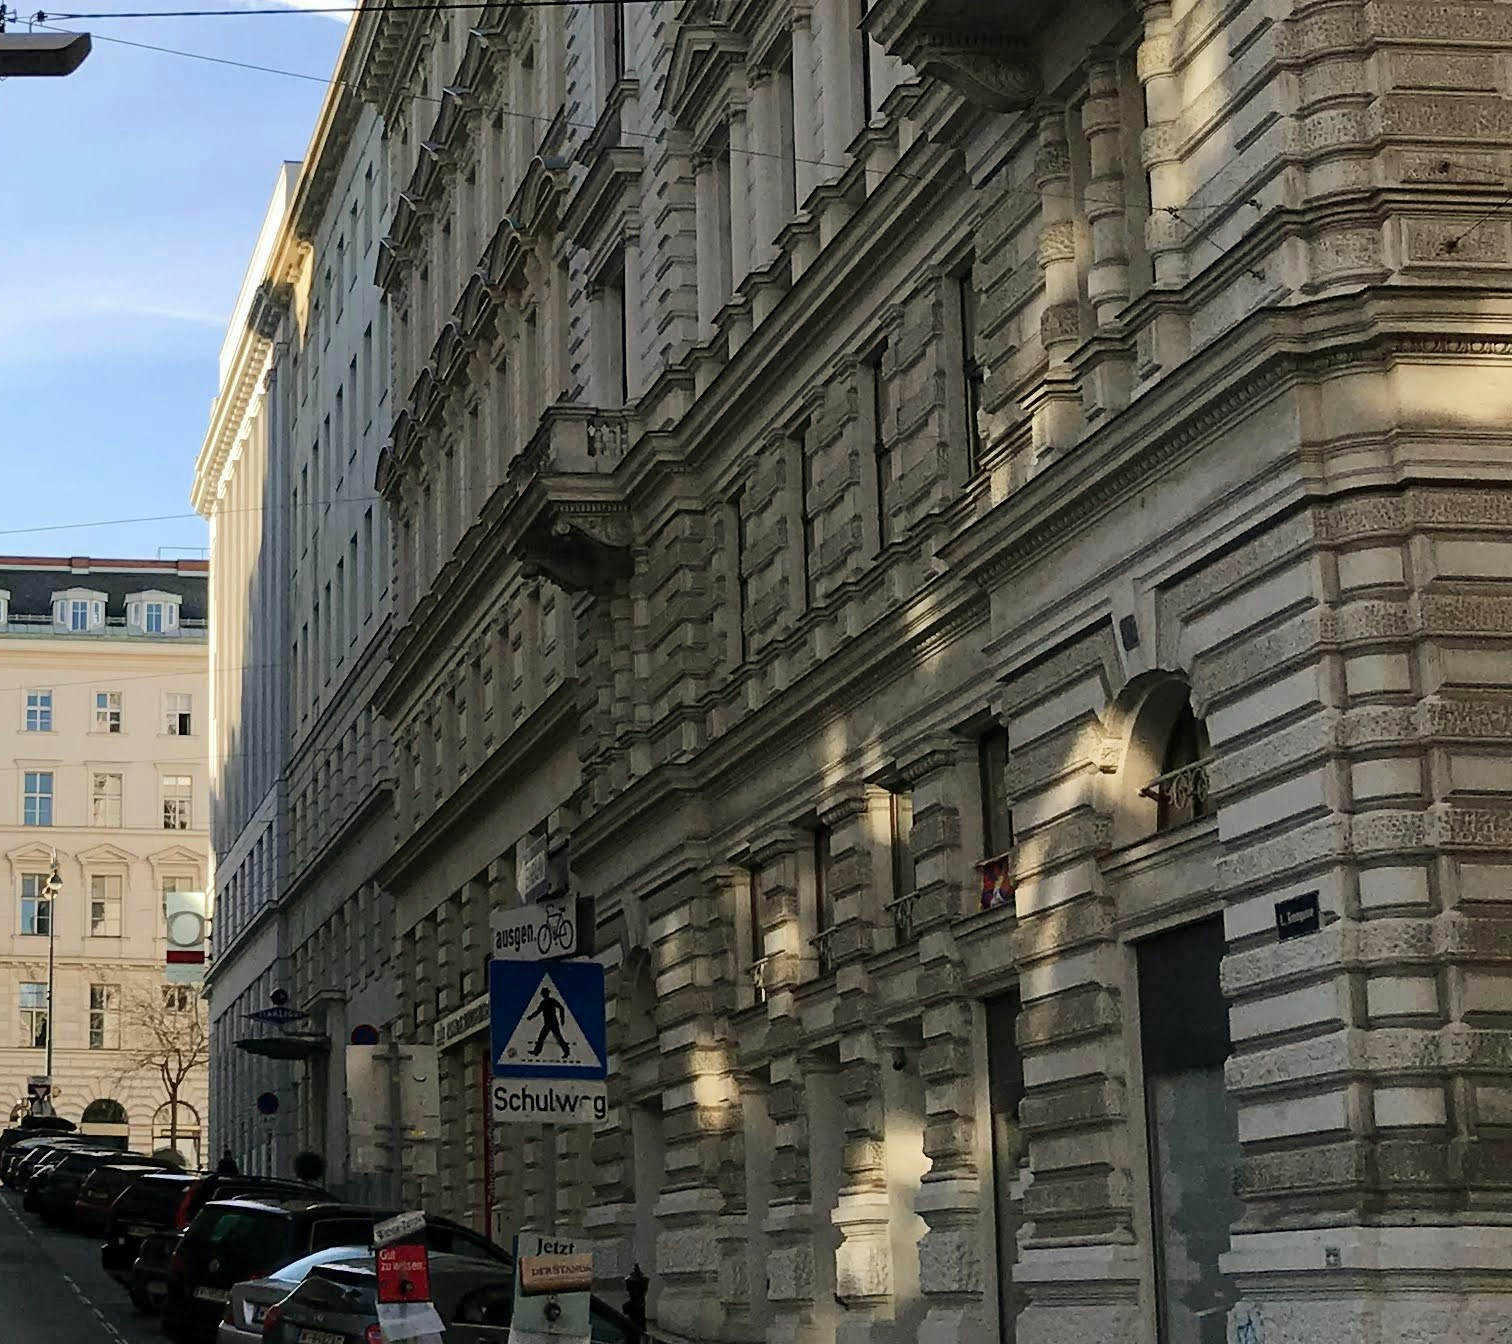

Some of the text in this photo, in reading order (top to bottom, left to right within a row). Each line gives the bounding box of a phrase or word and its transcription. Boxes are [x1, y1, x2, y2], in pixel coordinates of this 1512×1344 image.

[496, 924, 536, 952] ausgen.
[536, 1238, 575, 1256] Jetzt
[379, 1249, 396, 1260] Gut
[380, 1262, 391, 1271] zu
